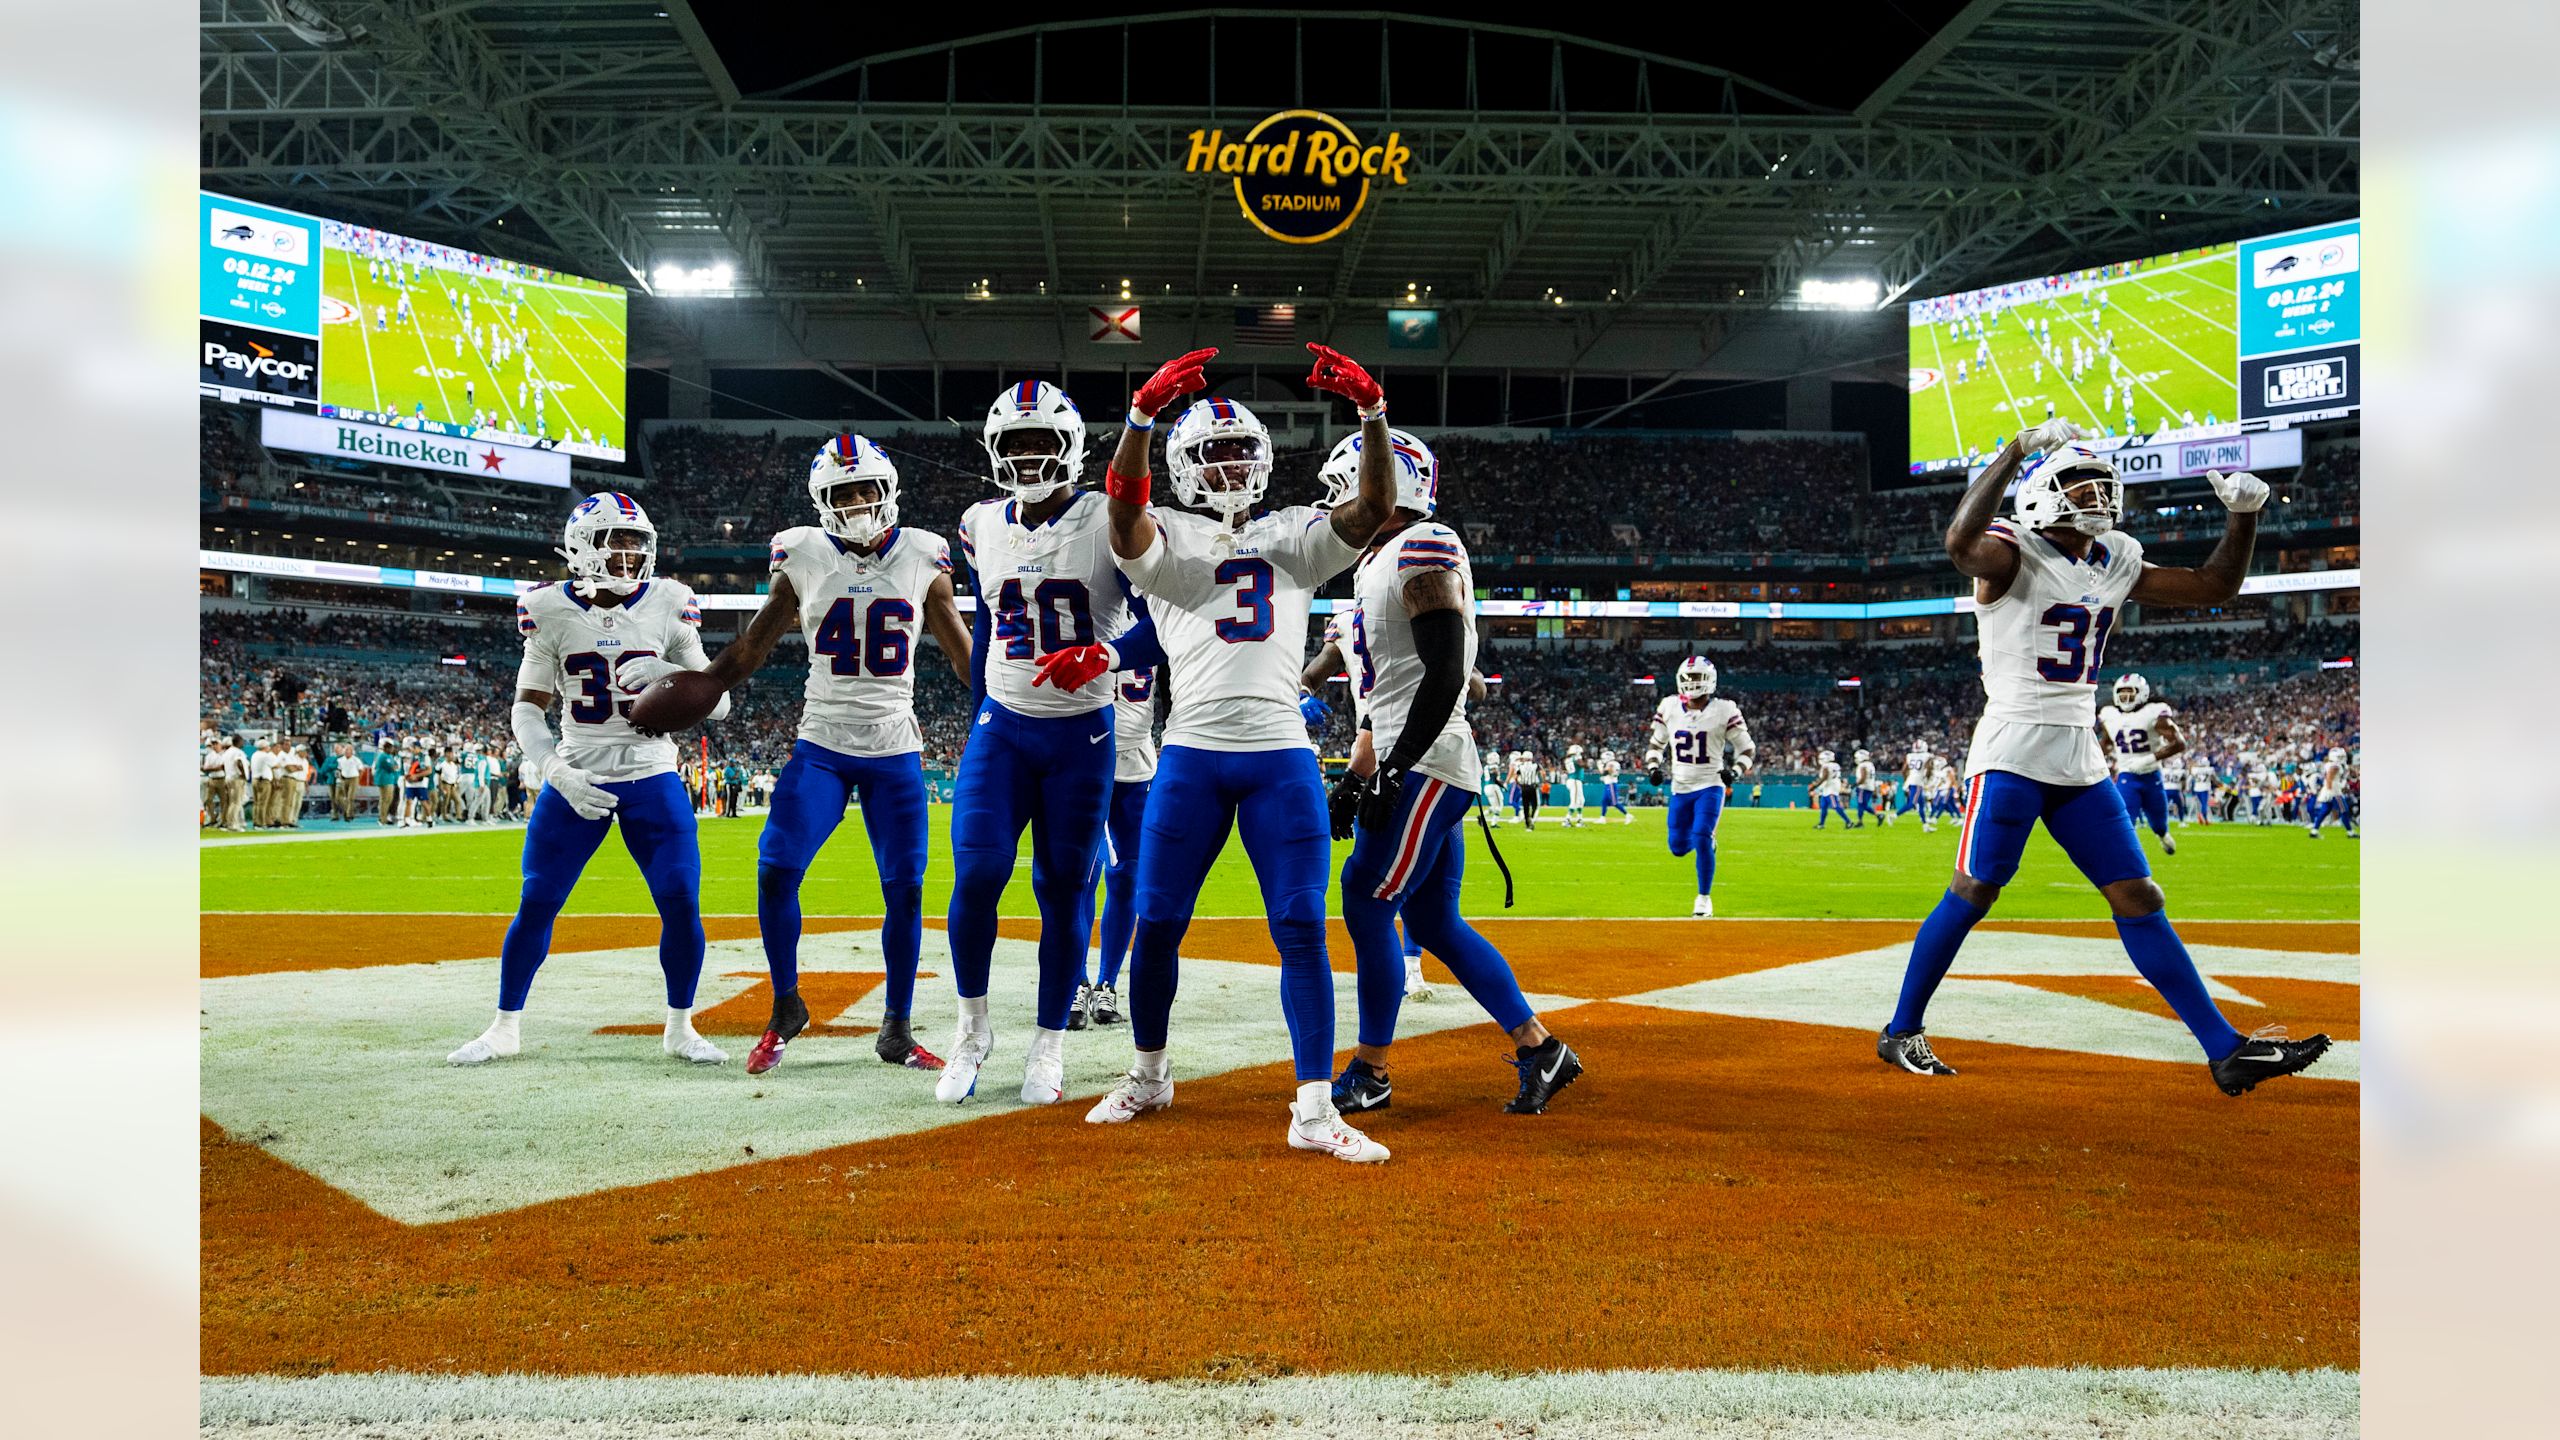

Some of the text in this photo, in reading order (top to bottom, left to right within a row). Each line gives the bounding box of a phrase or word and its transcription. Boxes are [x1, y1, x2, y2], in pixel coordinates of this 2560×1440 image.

[1186, 129, 1411, 186] Hard Rock
[1262, 194, 1341, 212] STADIUM
[223, 257, 296, 285] 09.12.24
[2267, 280, 2345, 308] 09.12.24
[205, 342, 314, 380] Paycor
[2279, 363, 2331, 386] BUD
[2269, 376, 2342, 402] LIGHT
[339, 407, 364, 421] BUF
[378, 413, 387, 425] 0
[424, 420, 447, 434] MIA
[460, 426, 469, 437] 0
[337, 427, 469, 467] Heineken
[2186, 445, 2243, 468] DRV PNK
[1926, 460, 1949, 472] BUF
[1961, 457, 1969, 468] 0
[271, 501, 349, 518] SUPER BOWL VII
[400, 516, 545, 541] 1972 PERFECT SEASON TEAM 17-0
[428, 575, 471, 588] Hard Rock
[1017, 565, 1043, 573] BILLS
[1214, 557, 1275, 644] 3
[2081, 595, 2100, 604] BILLS
[995, 578, 1096, 660] 40
[815, 597, 915, 677] 46
[2036, 603, 2115, 684] 31
[1674, 729, 1711, 764] 21
[2115, 729, 2151, 753] 42
